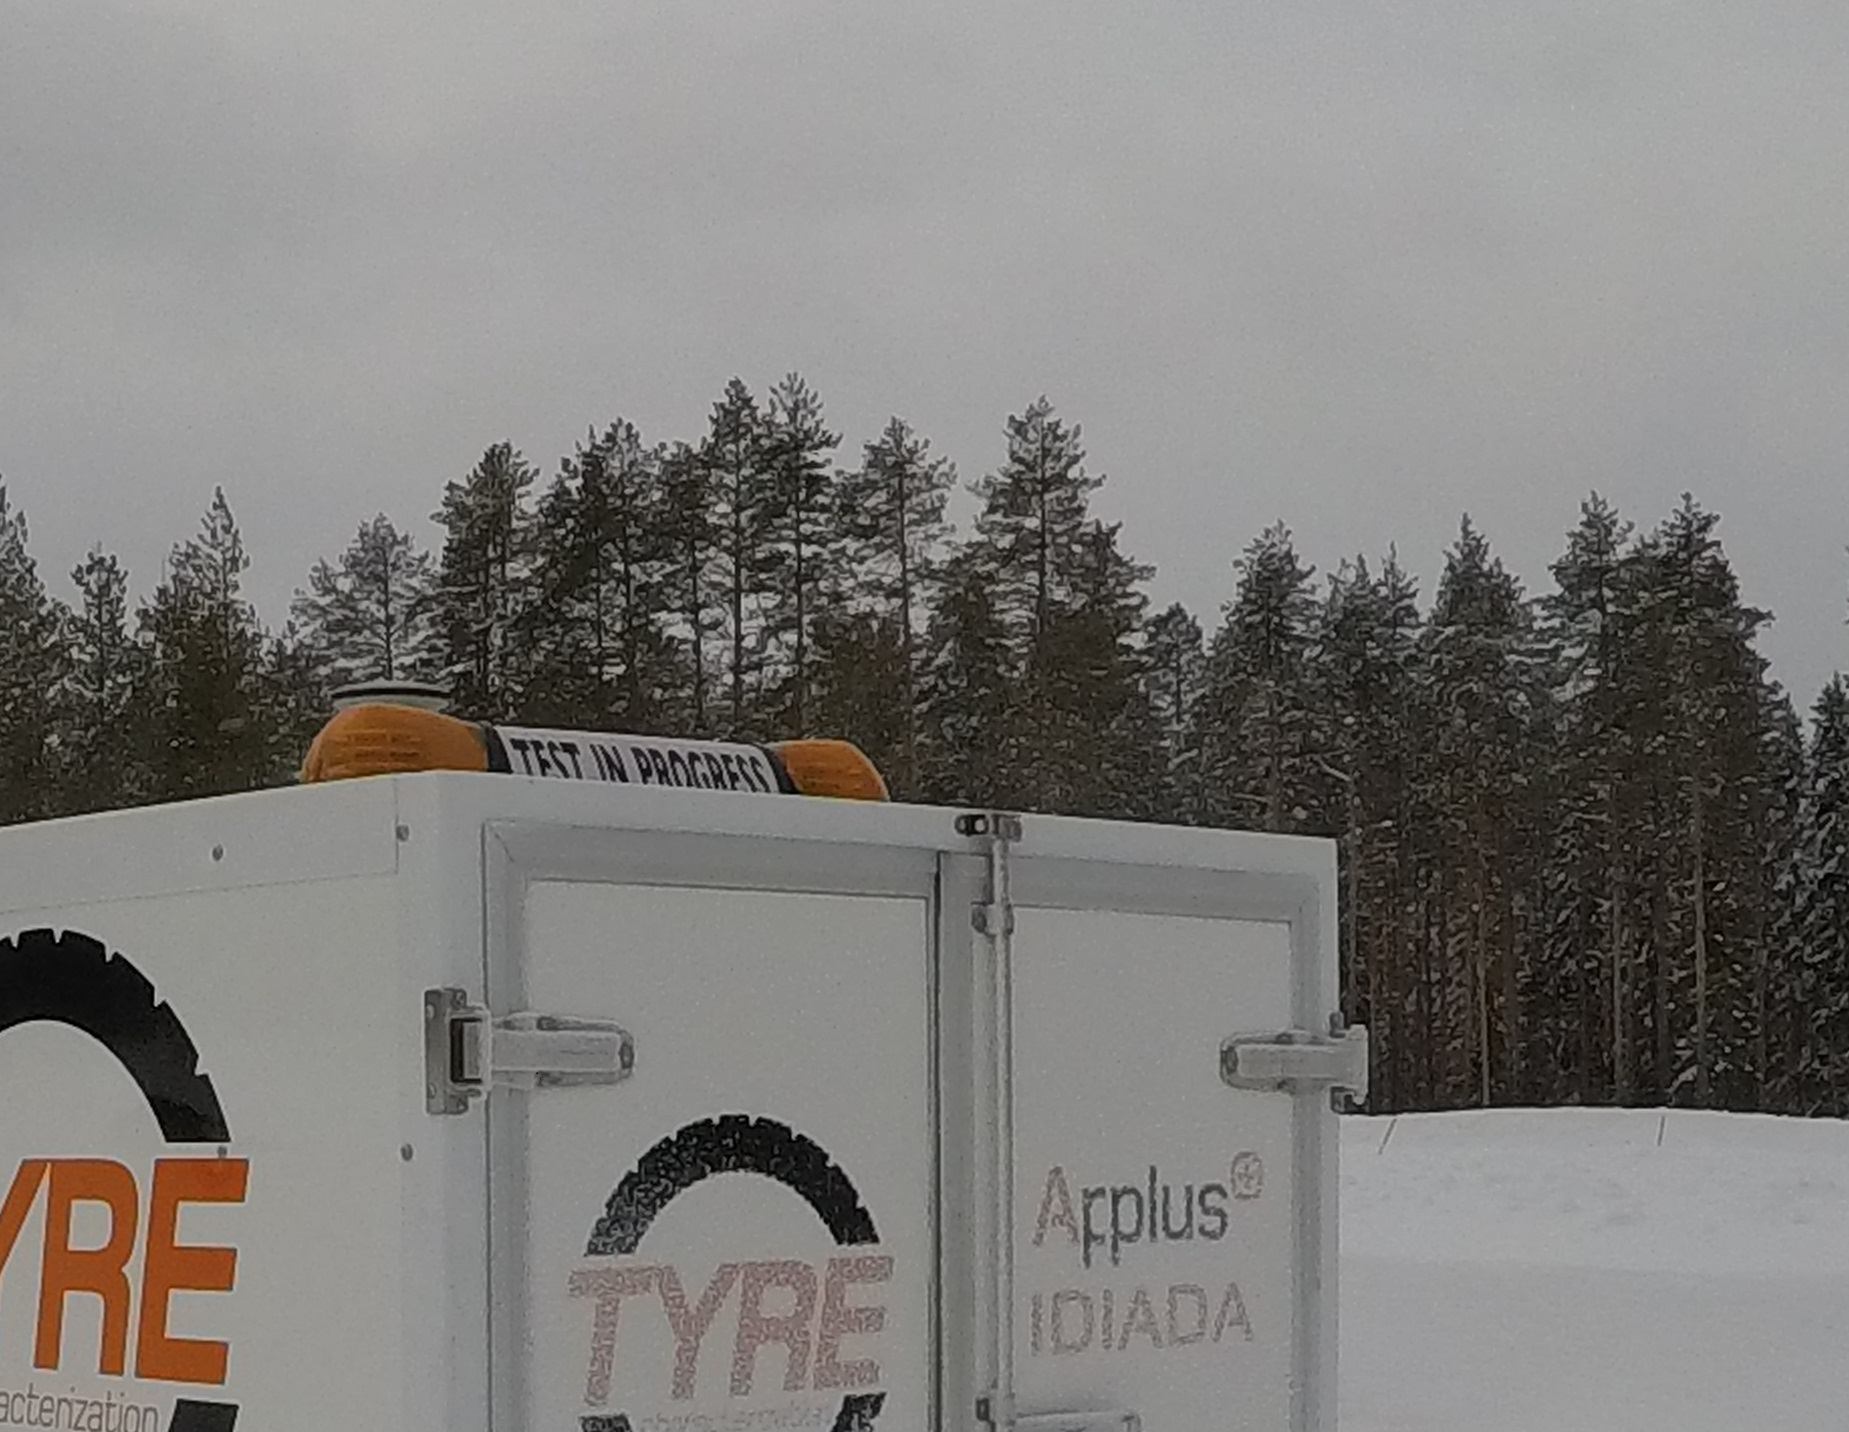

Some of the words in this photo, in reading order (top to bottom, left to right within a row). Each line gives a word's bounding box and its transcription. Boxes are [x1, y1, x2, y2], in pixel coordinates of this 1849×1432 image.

[510, 738, 583, 780] TEST
[589, 744, 629, 783] IN
[630, 746, 773, 793] PROGRESS
[568, 1255, 894, 1405] TYRE
[1031, 1281, 1253, 1356] IDIADA
